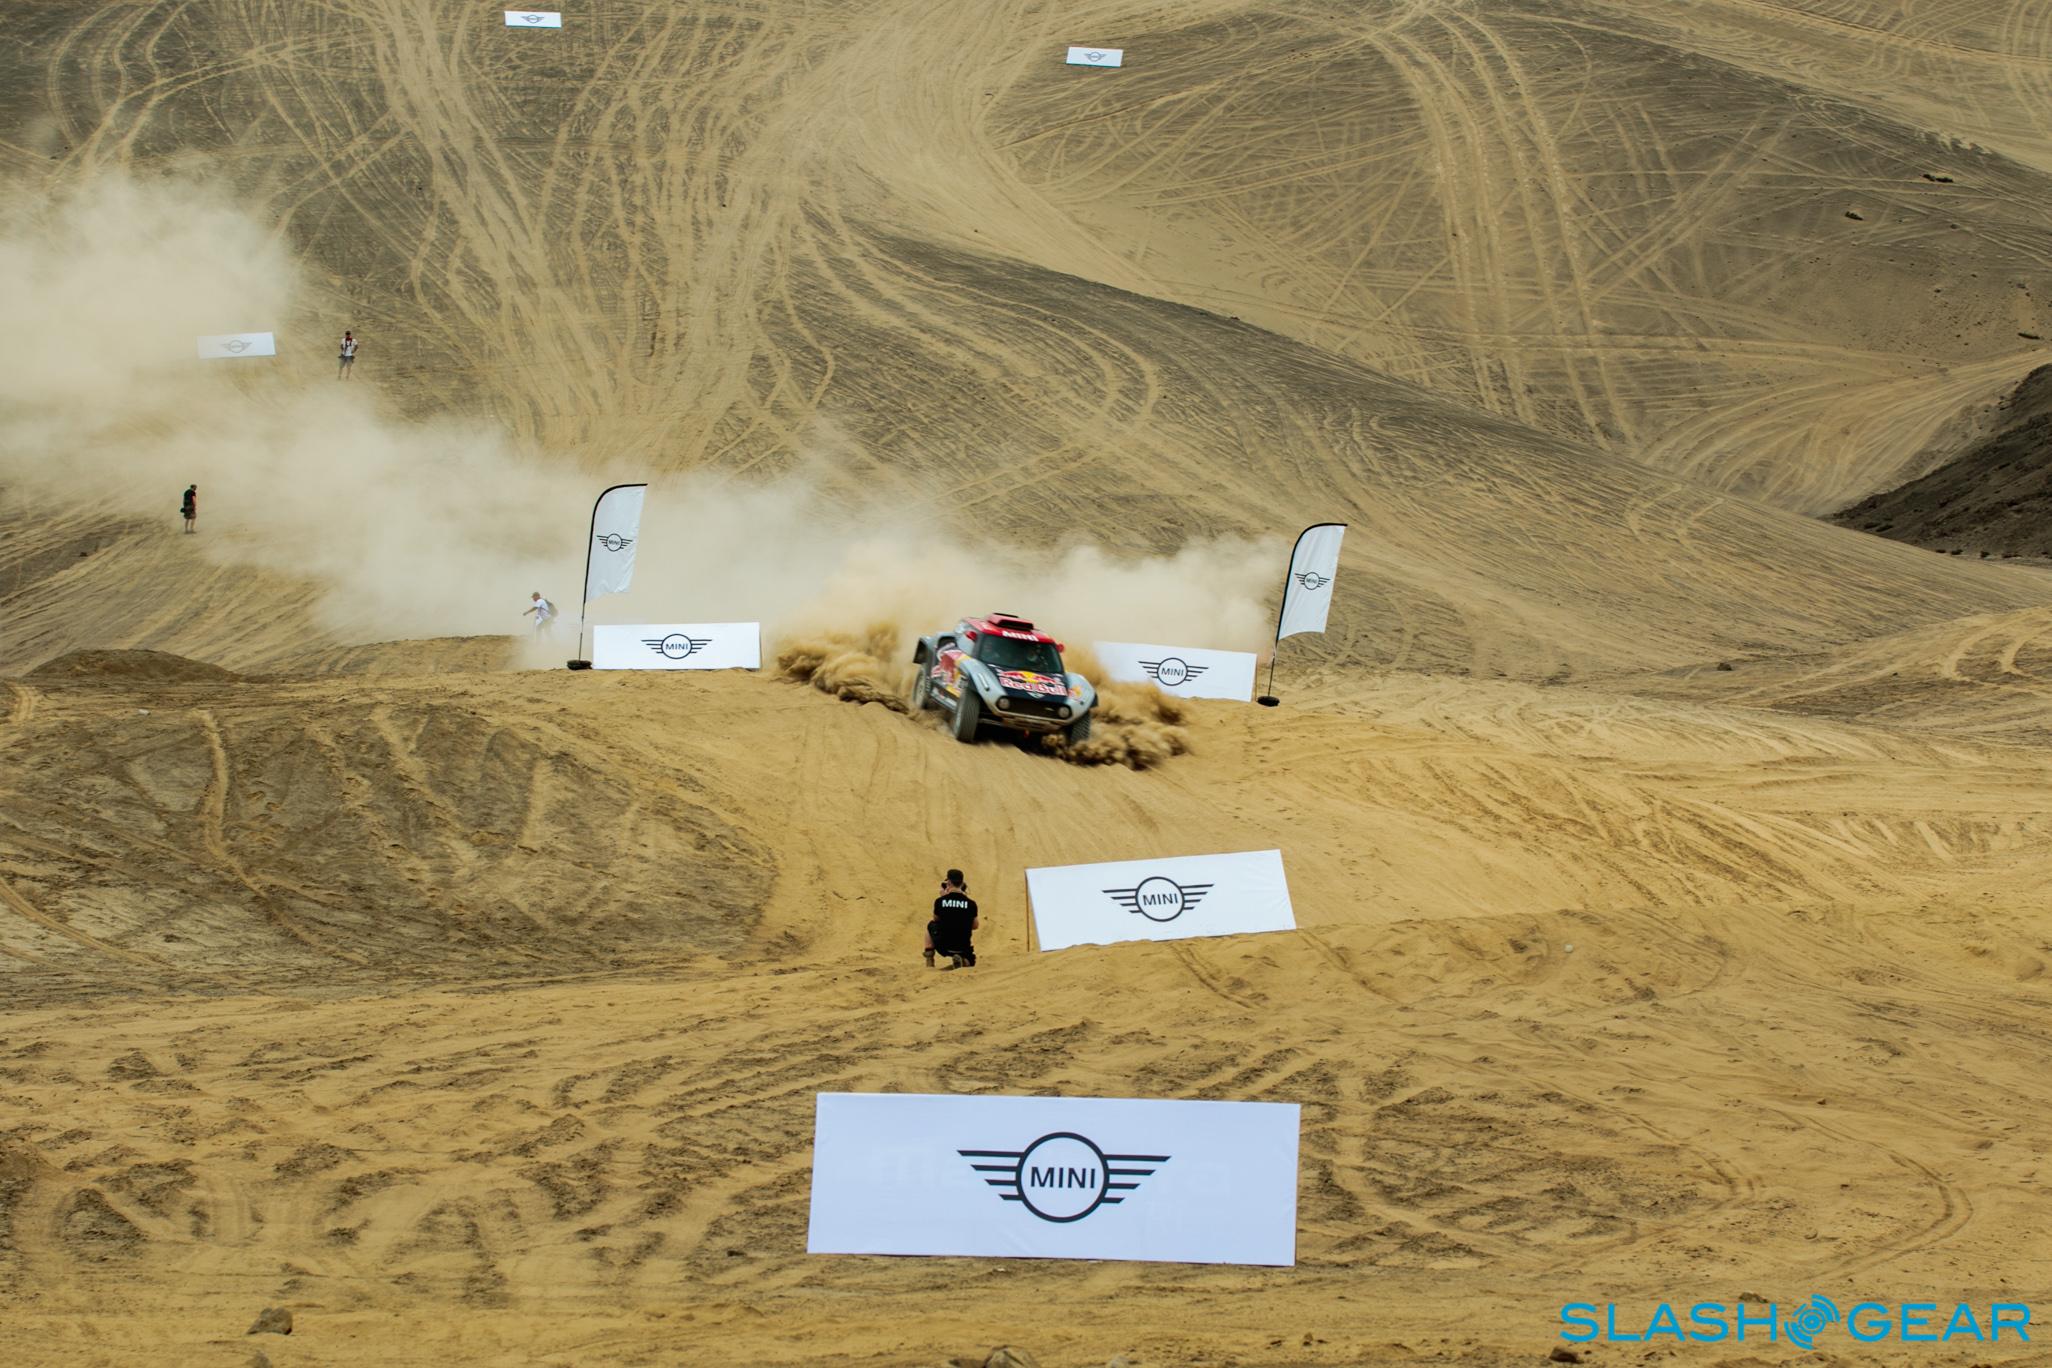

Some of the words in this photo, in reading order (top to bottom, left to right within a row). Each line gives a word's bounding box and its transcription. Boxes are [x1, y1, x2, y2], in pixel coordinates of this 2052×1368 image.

[1160, 667, 1184, 677] MINI
[999, 676, 1033, 691] Red
[1036, 683, 1068, 697] Bull
[942, 899, 968, 909] MINI
[1143, 893, 1178, 906] MINI
[1030, 1166, 1096, 1189] MINI
